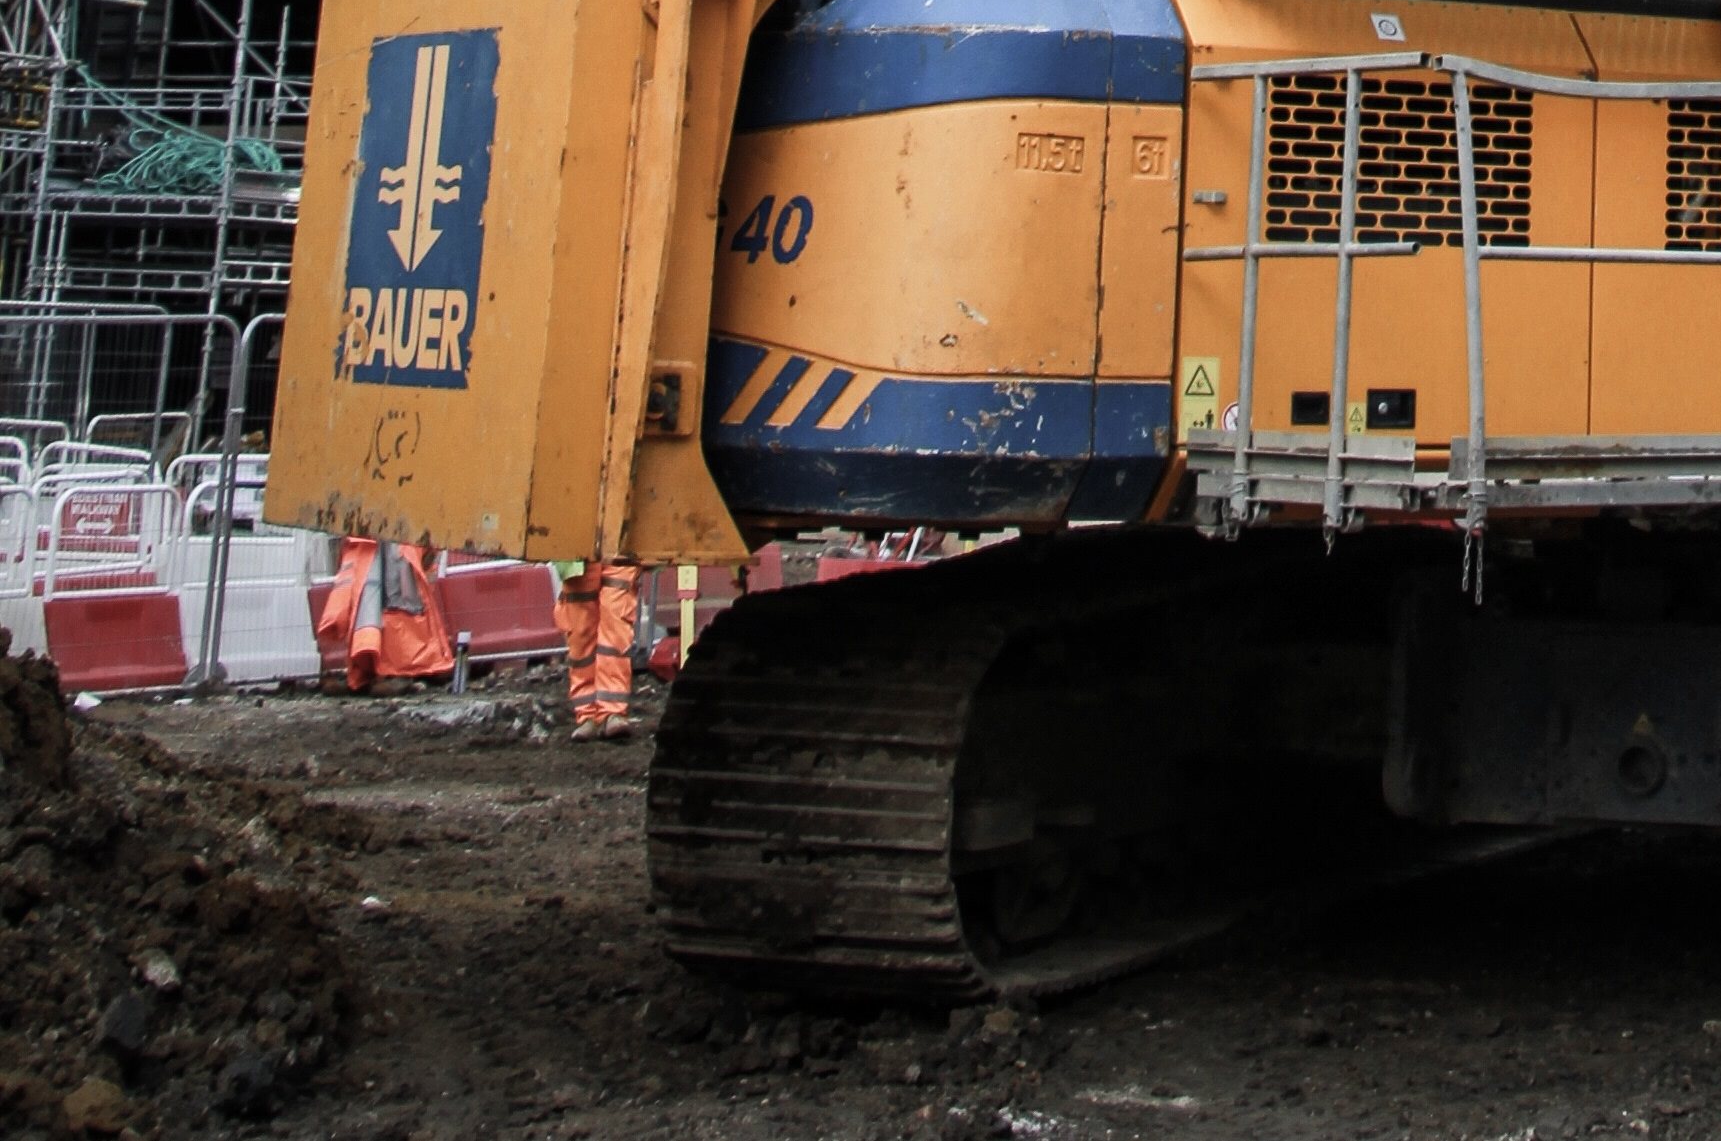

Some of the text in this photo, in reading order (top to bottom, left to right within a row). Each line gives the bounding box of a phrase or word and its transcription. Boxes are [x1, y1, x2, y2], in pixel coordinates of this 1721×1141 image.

[1136, 140, 1164, 174] 6t
[731, 194, 814, 265] 40
[343, 287, 468, 371] BAUER
[71, 504, 121, 516] WALKWAY
